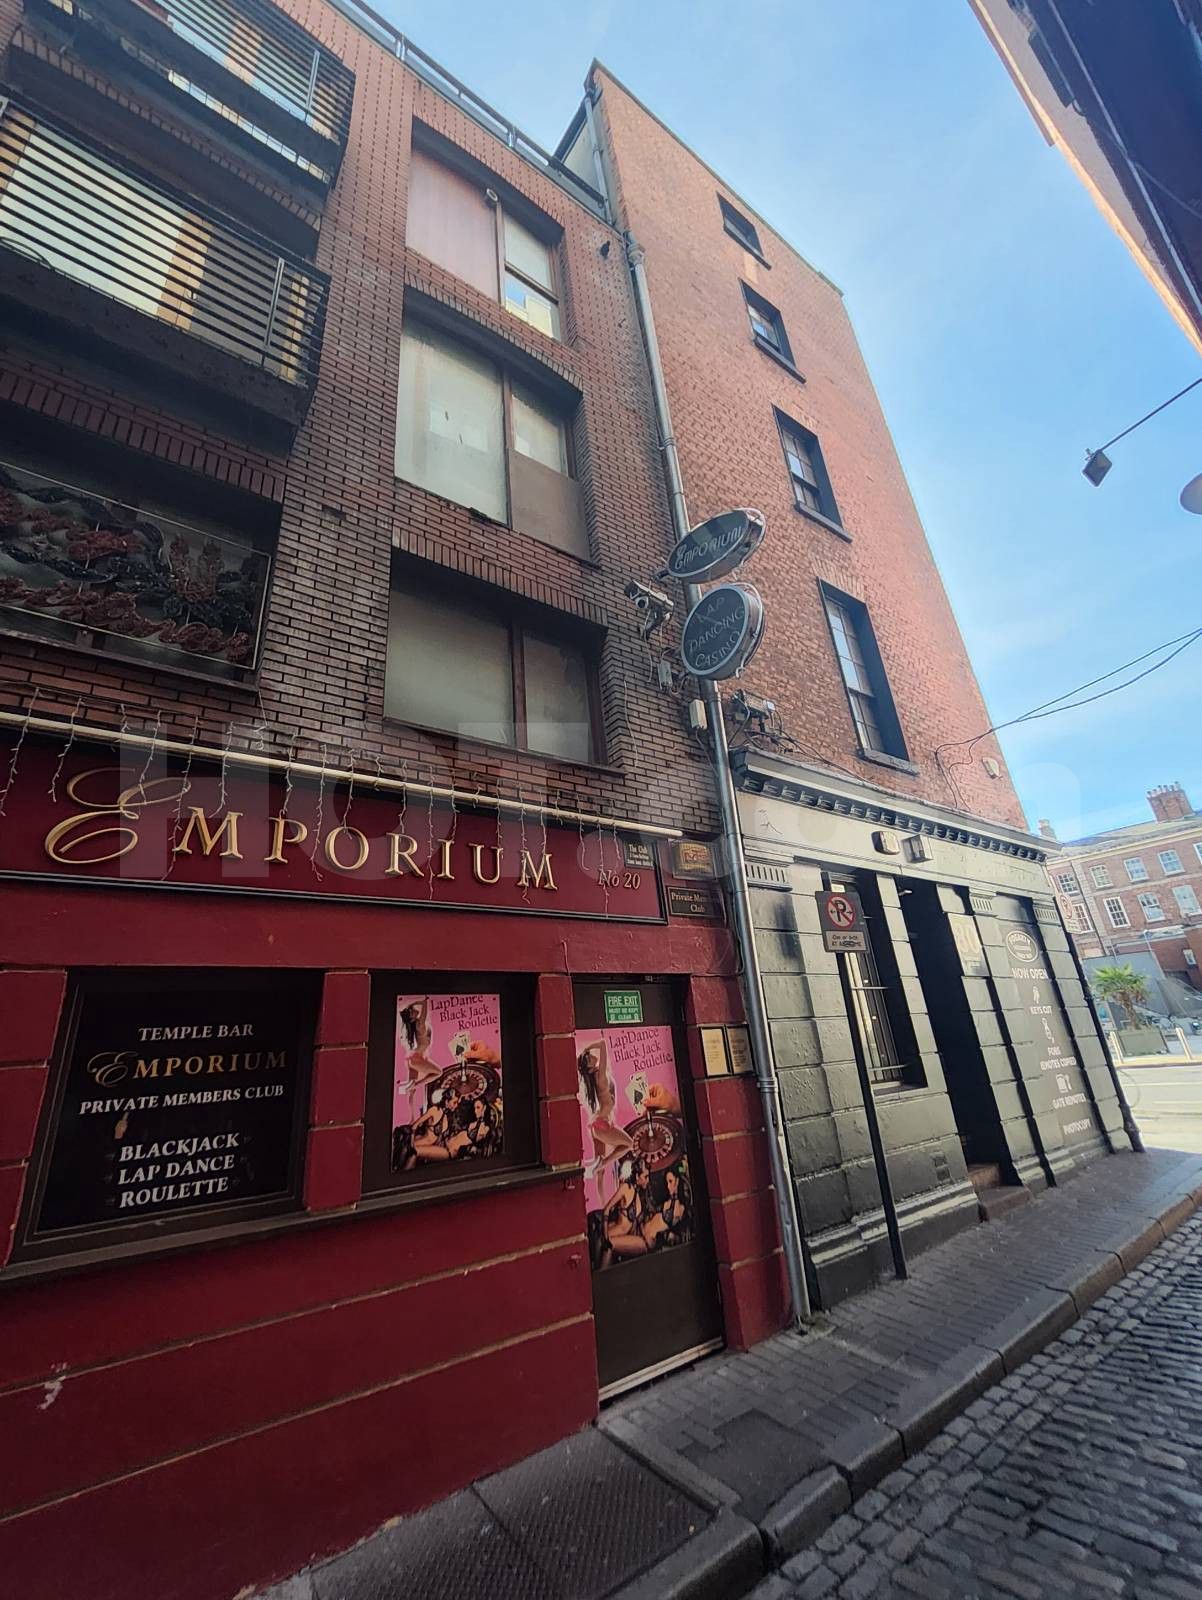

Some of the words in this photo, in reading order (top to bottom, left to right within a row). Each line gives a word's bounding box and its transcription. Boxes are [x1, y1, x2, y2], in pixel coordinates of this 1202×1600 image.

[689, 607, 745, 655] DANCING
[695, 630, 741, 667] CASINO
[45, 767, 558, 891] EMPORIUM
[624, 872, 641, 889] 20
[440, 1008, 467, 1023] Black
[469, 1004, 490, 1020] Jack
[458, 1016, 498, 1031] Roulette
[138, 1026, 213, 1041] TEMPLE
[217, 1024, 254, 1038] BAR
[614, 1045, 640, 1063] Black
[641, 1040, 661, 1058] Jack
[633, 1052, 673, 1072] Roulette
[87, 1051, 287, 1088] EMPORIUM
[79, 1095, 159, 1115] PRIVATE
[162, 1088, 241, 1107] MEMBERS
[244, 1085, 284, 1099] CLUB
[119, 1132, 240, 1162] BLACKJACK
[118, 1165, 161, 1185] LAP
[165, 1154, 235, 1178] DANCE
[119, 1176, 229, 1208] ROULETTE
